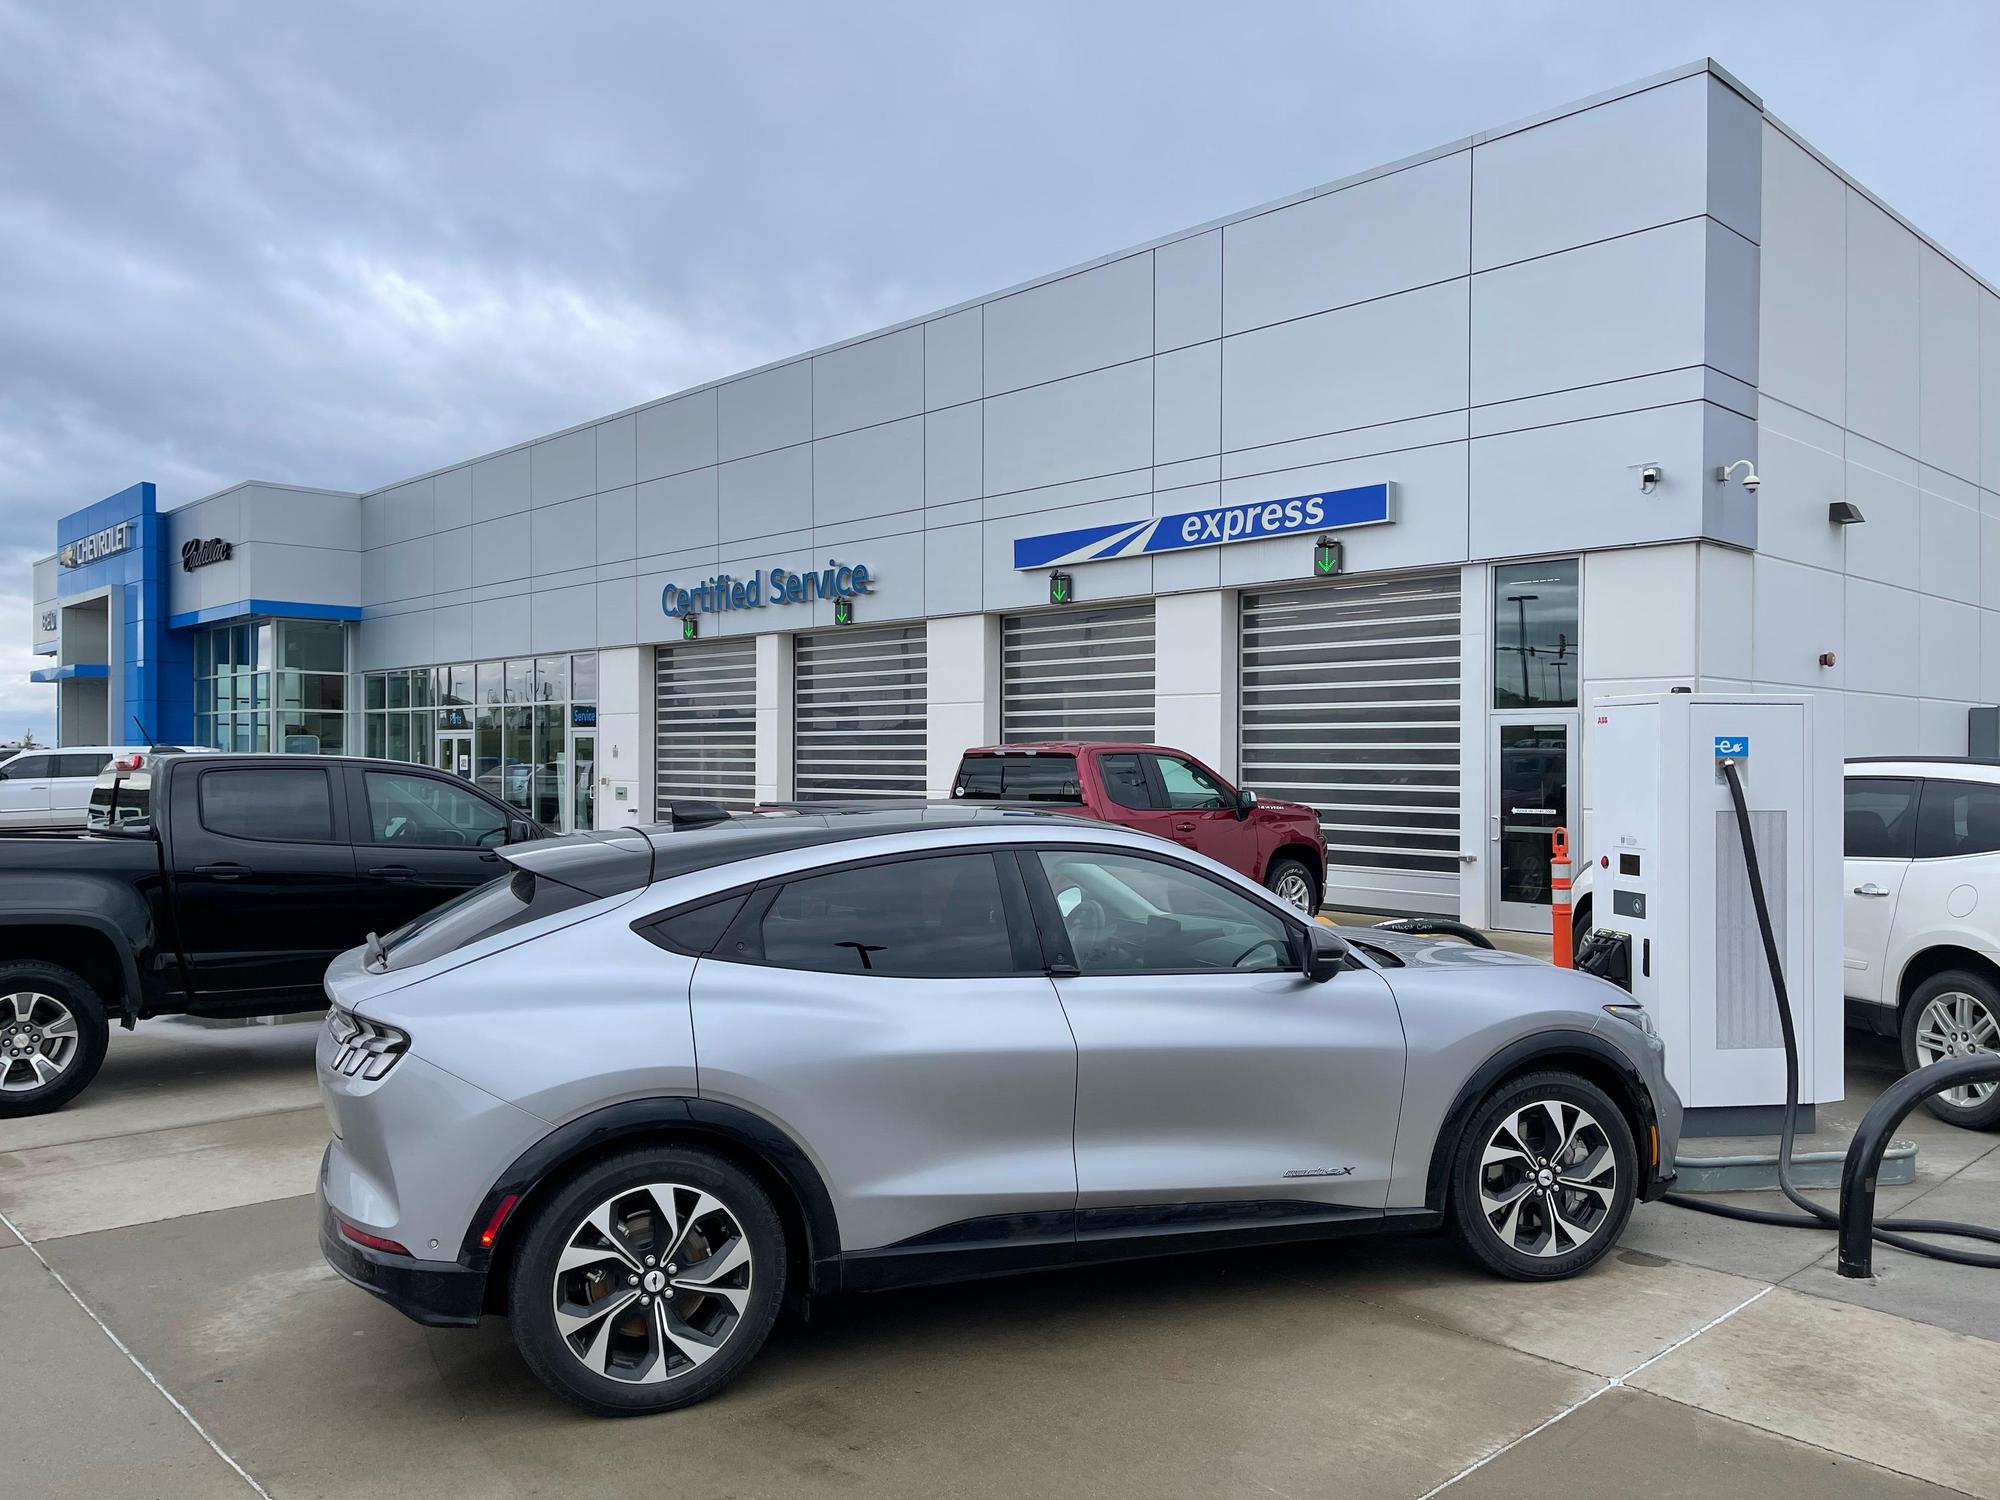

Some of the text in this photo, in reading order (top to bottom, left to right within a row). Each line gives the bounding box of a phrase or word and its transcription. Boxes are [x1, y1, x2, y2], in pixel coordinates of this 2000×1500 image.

[1181, 497, 1325, 543] express
[77, 522, 128, 564] CHEVROLET
[183, 538, 230, 572] Cadillac
[662, 558, 870, 617] Certified Service
[574, 710, 595, 722] Service
[1597, 716, 1608, 724] ABB
